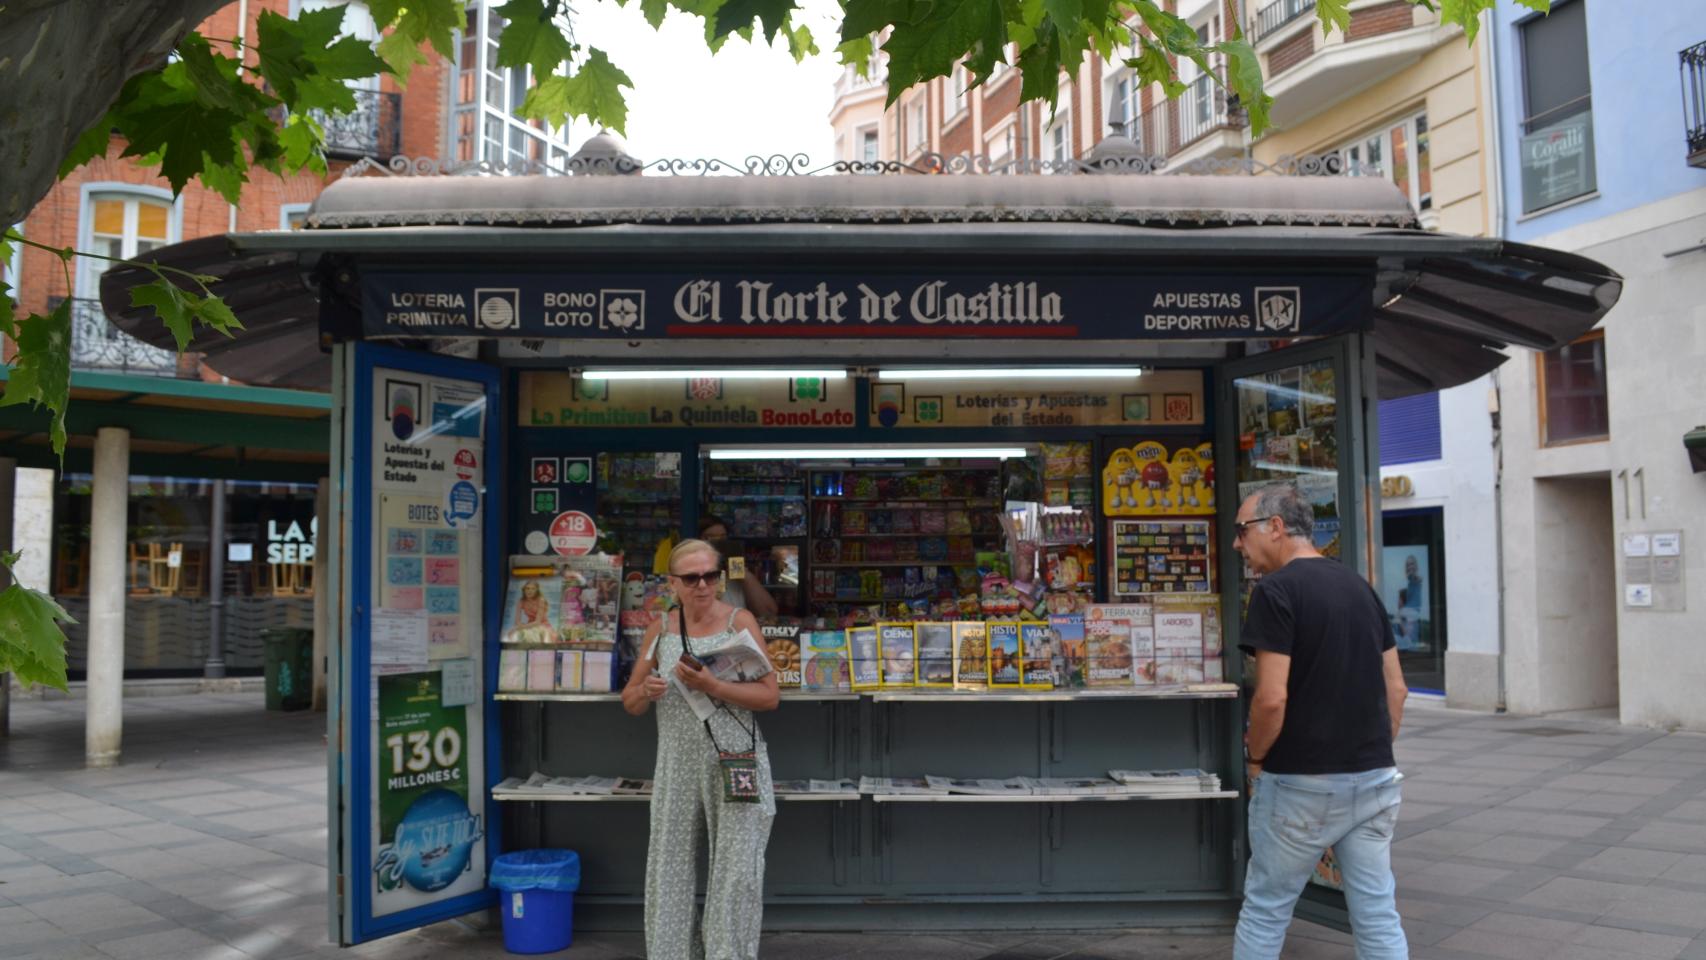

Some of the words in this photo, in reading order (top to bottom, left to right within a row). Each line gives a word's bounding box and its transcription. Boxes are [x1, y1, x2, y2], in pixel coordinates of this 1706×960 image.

[392, 292, 465, 308] LOTERIA
[544, 293, 597, 308] BONO
[673, 280, 724, 323] El
[736, 280, 848, 324] Norte
[857, 283, 902, 324] de
[910, 280, 1064, 324] Castilla
[1153, 293, 1241, 309] APUESTAS
[386, 312, 468, 327] PRIMITIVA
[545, 312, 593, 327] LOTO
[1144, 314, 1251, 331] DEPORTIVAS
[1024, 396, 1034, 410] y
[1039, 393, 1108, 410] Apuestas
[531, 408, 554, 425] La
[560, 406, 648, 426] Primitiva
[651, 407, 674, 424] La
[679, 405, 758, 426] Quiniela
[762, 408, 854, 426] BonoLoto
[992, 413, 1014, 426] del
[1022, 412, 1074, 426] Estado
[425, 448, 431, 459] y
[385, 456, 428, 472] Apuestas
[431, 460, 445, 471] del
[384, 471, 417, 483] Estado
[1618, 467, 1646, 520] 11
[408, 504, 439, 521] BOTES
[267, 519, 306, 542] LA
[559, 515, 586, 532] +18
[1161, 618, 1194, 626] LABORES
[761, 626, 800, 638] muy
[776, 671, 801, 684] LTAS
[386, 726, 461, 774] 130
[388, 769, 450, 790] MILLONES
